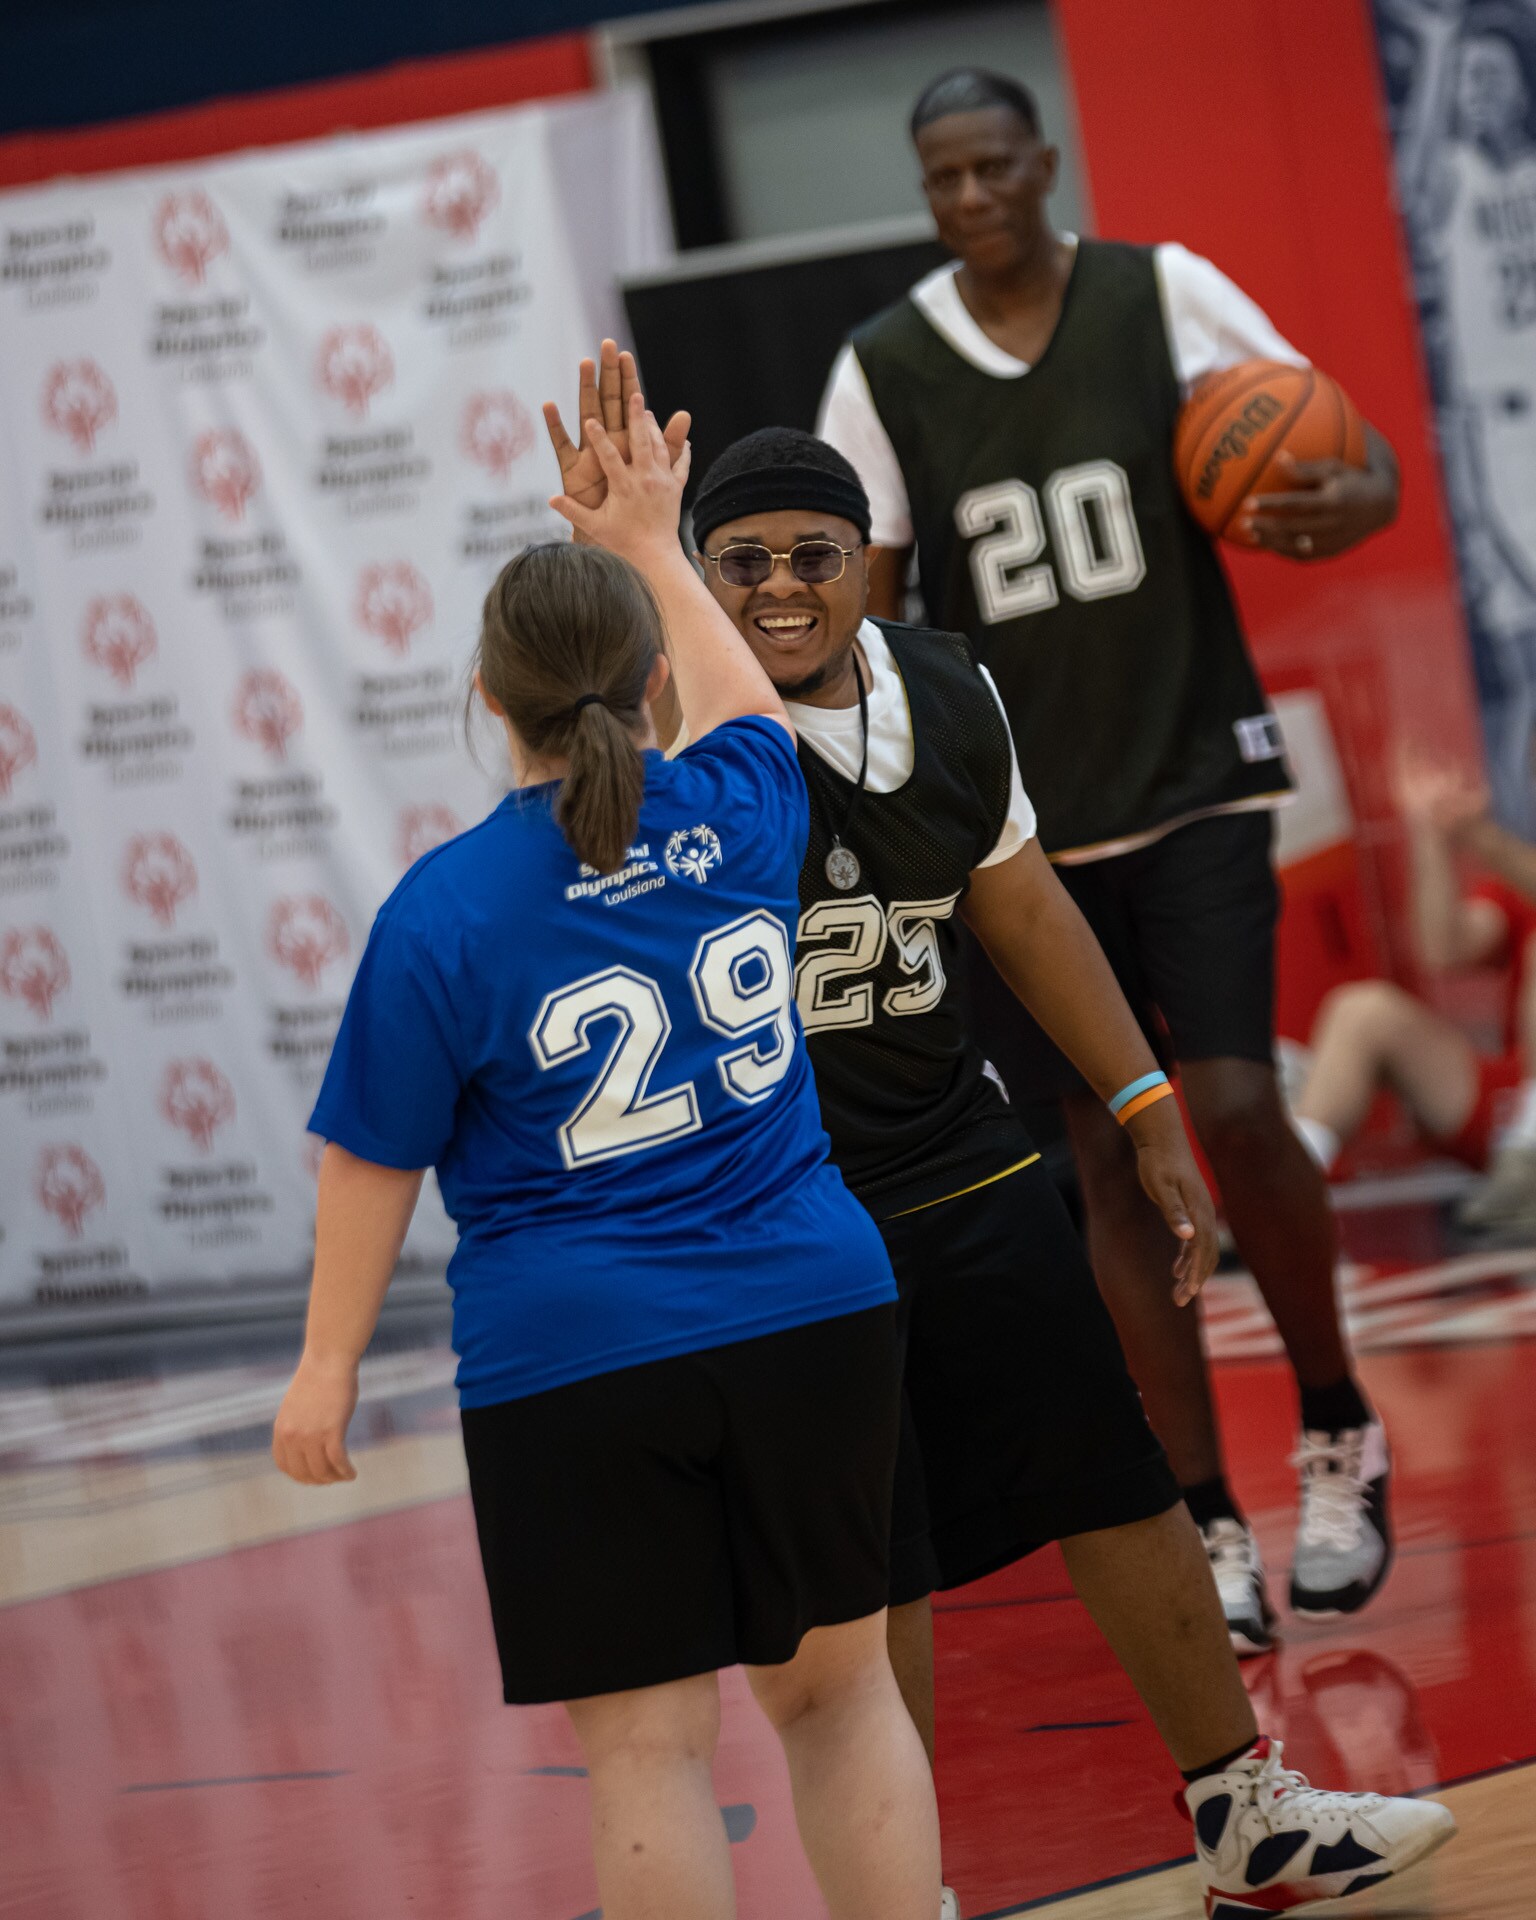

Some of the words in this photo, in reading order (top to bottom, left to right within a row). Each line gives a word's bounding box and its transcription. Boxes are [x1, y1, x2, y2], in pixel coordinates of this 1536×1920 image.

[954, 458, 1147, 625] 20
[565, 861, 659, 900] Olympics
[604, 875, 666, 906] Louisiana
[793, 893, 963, 1036] 25
[527, 908, 796, 1171] 29
